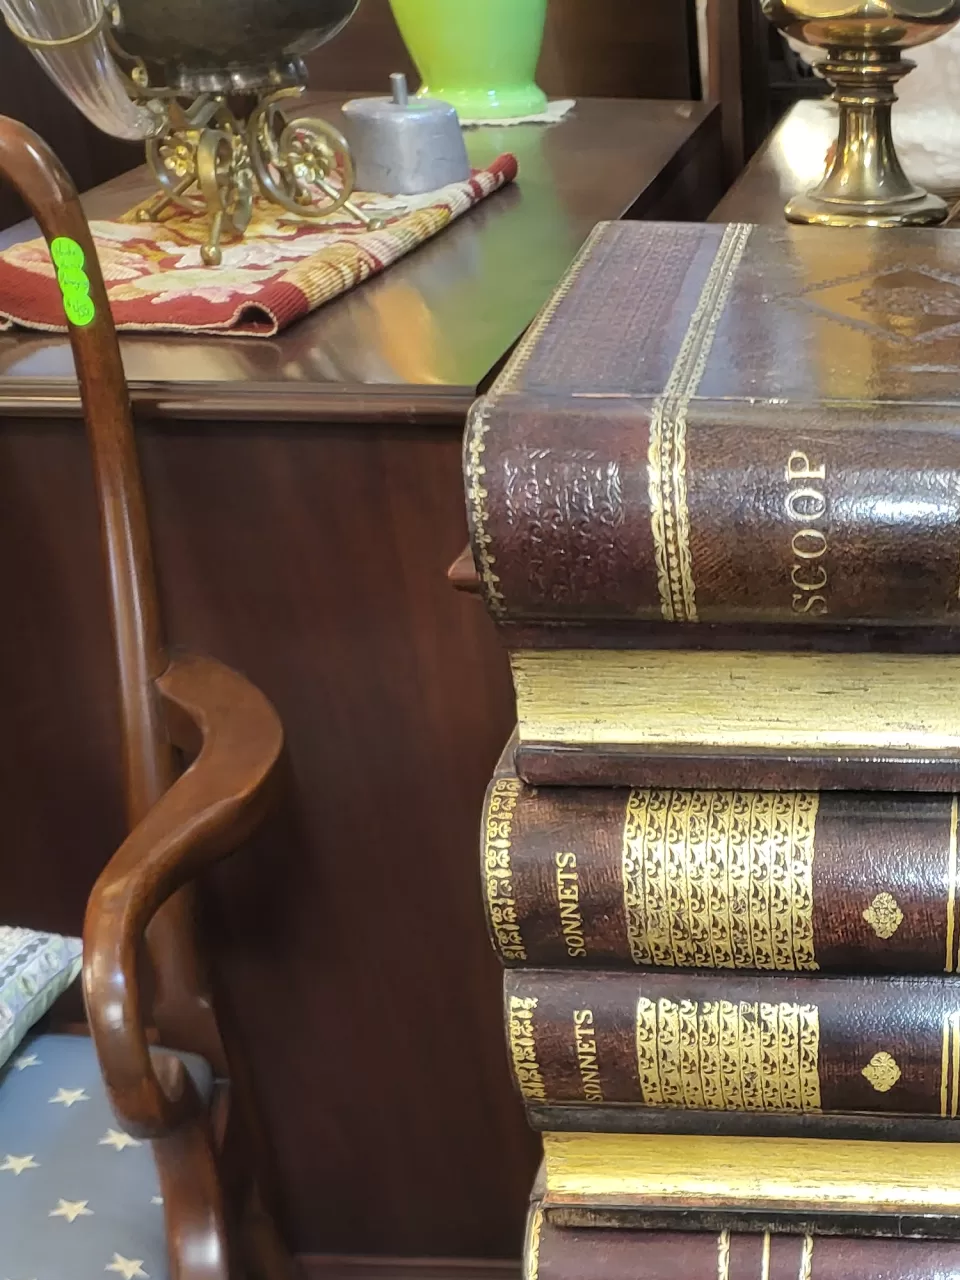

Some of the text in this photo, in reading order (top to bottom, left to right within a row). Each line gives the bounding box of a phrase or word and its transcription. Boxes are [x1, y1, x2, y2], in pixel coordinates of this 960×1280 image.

[785, 450, 828, 614] SCOOP
[556, 851, 587, 958] SONNETS
[573, 1009, 603, 1102] SONNETS
